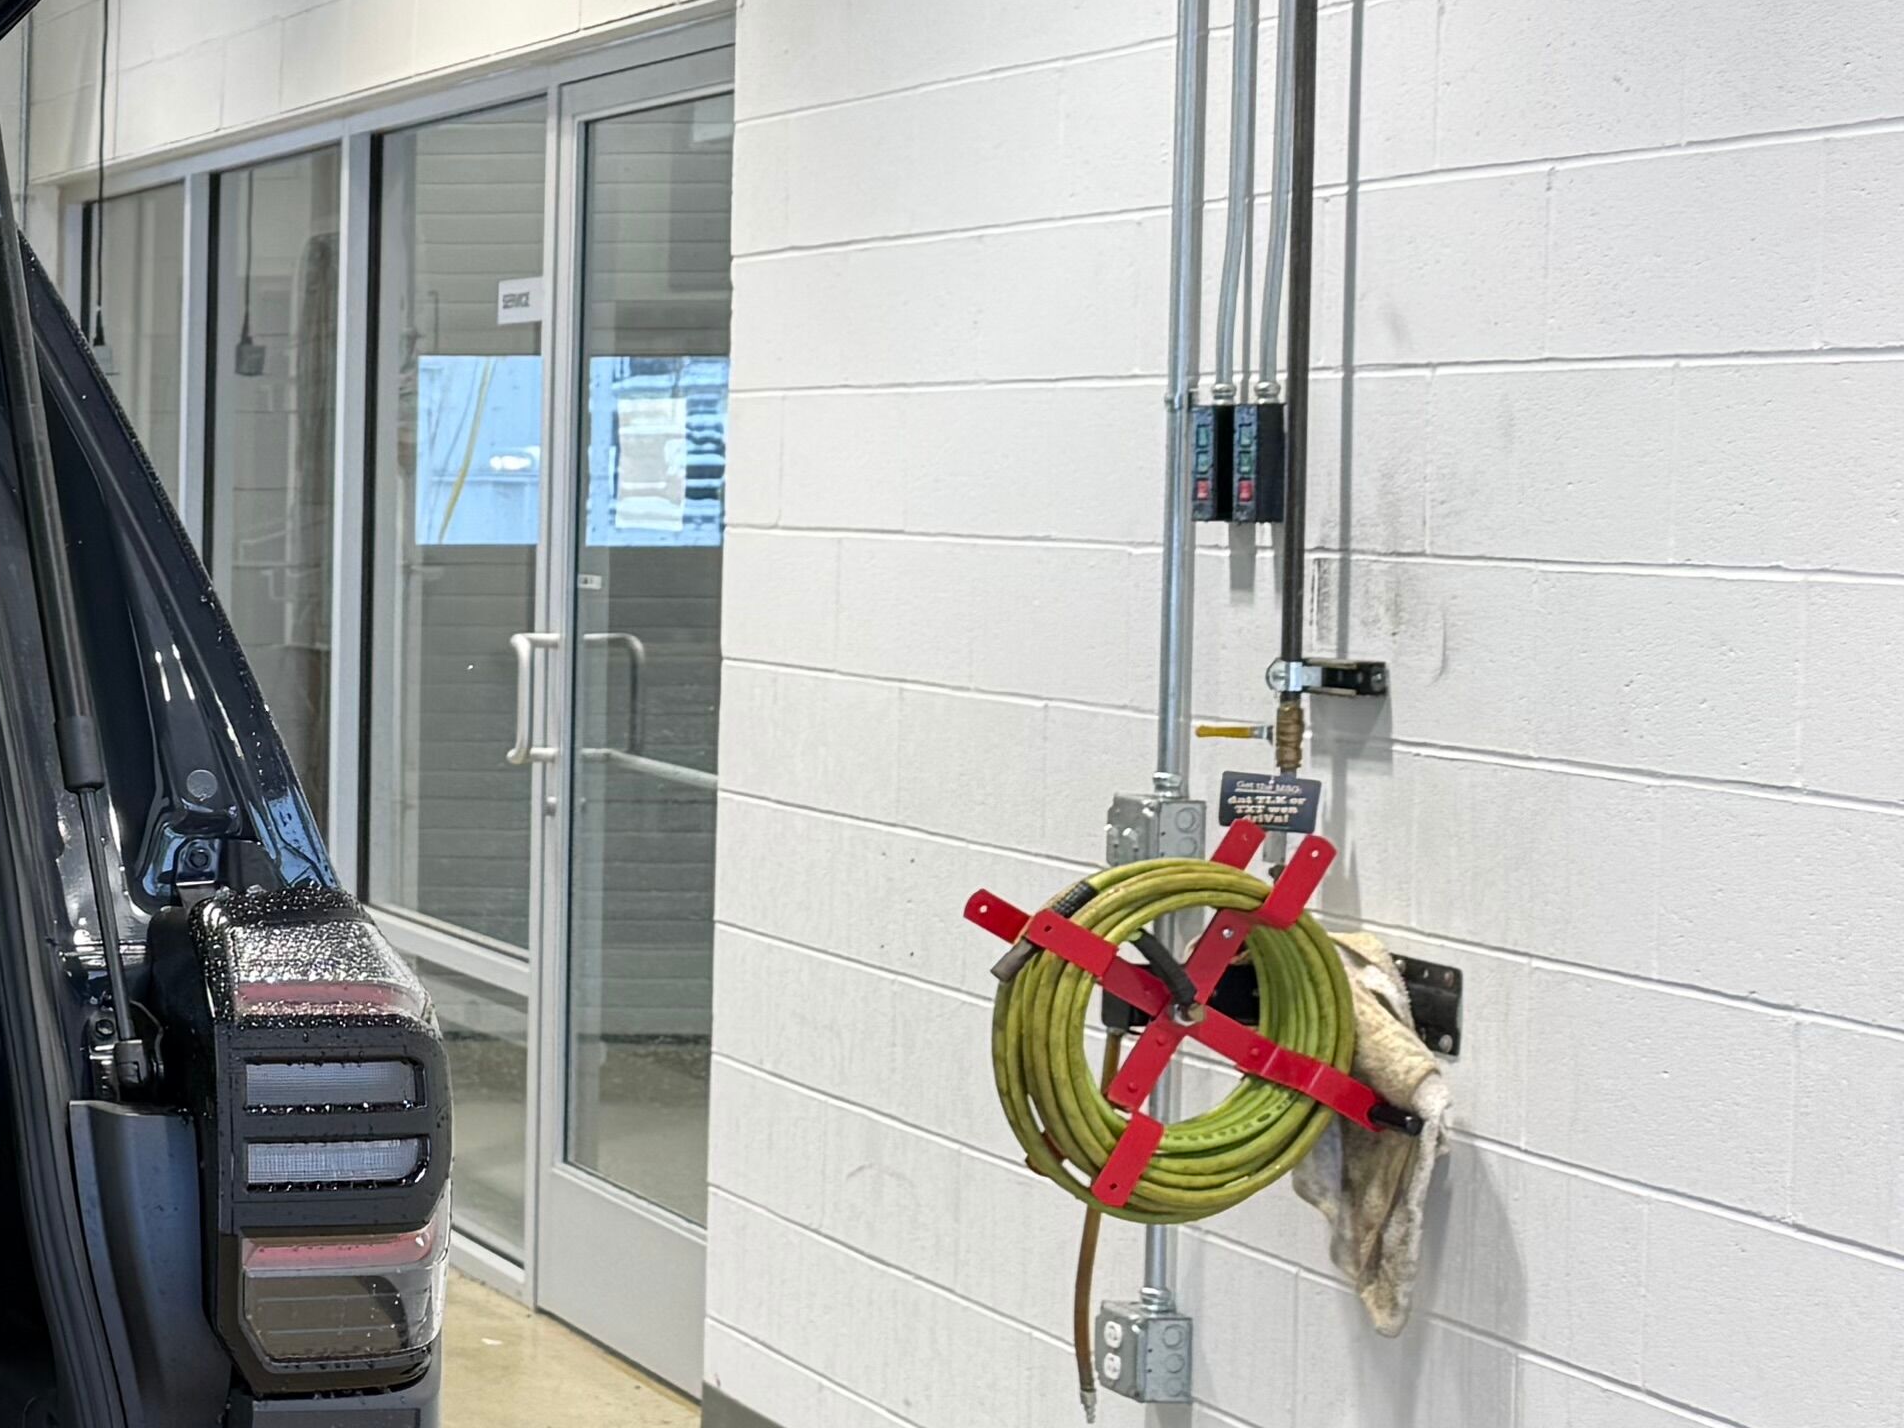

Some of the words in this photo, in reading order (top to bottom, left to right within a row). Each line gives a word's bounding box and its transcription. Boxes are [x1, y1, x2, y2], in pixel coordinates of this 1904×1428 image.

[1255, 795, 1287, 805] TLK
[1289, 797, 1307, 805] or
[1234, 805, 1265, 814] TXT
[1267, 806, 1298, 814] wen
